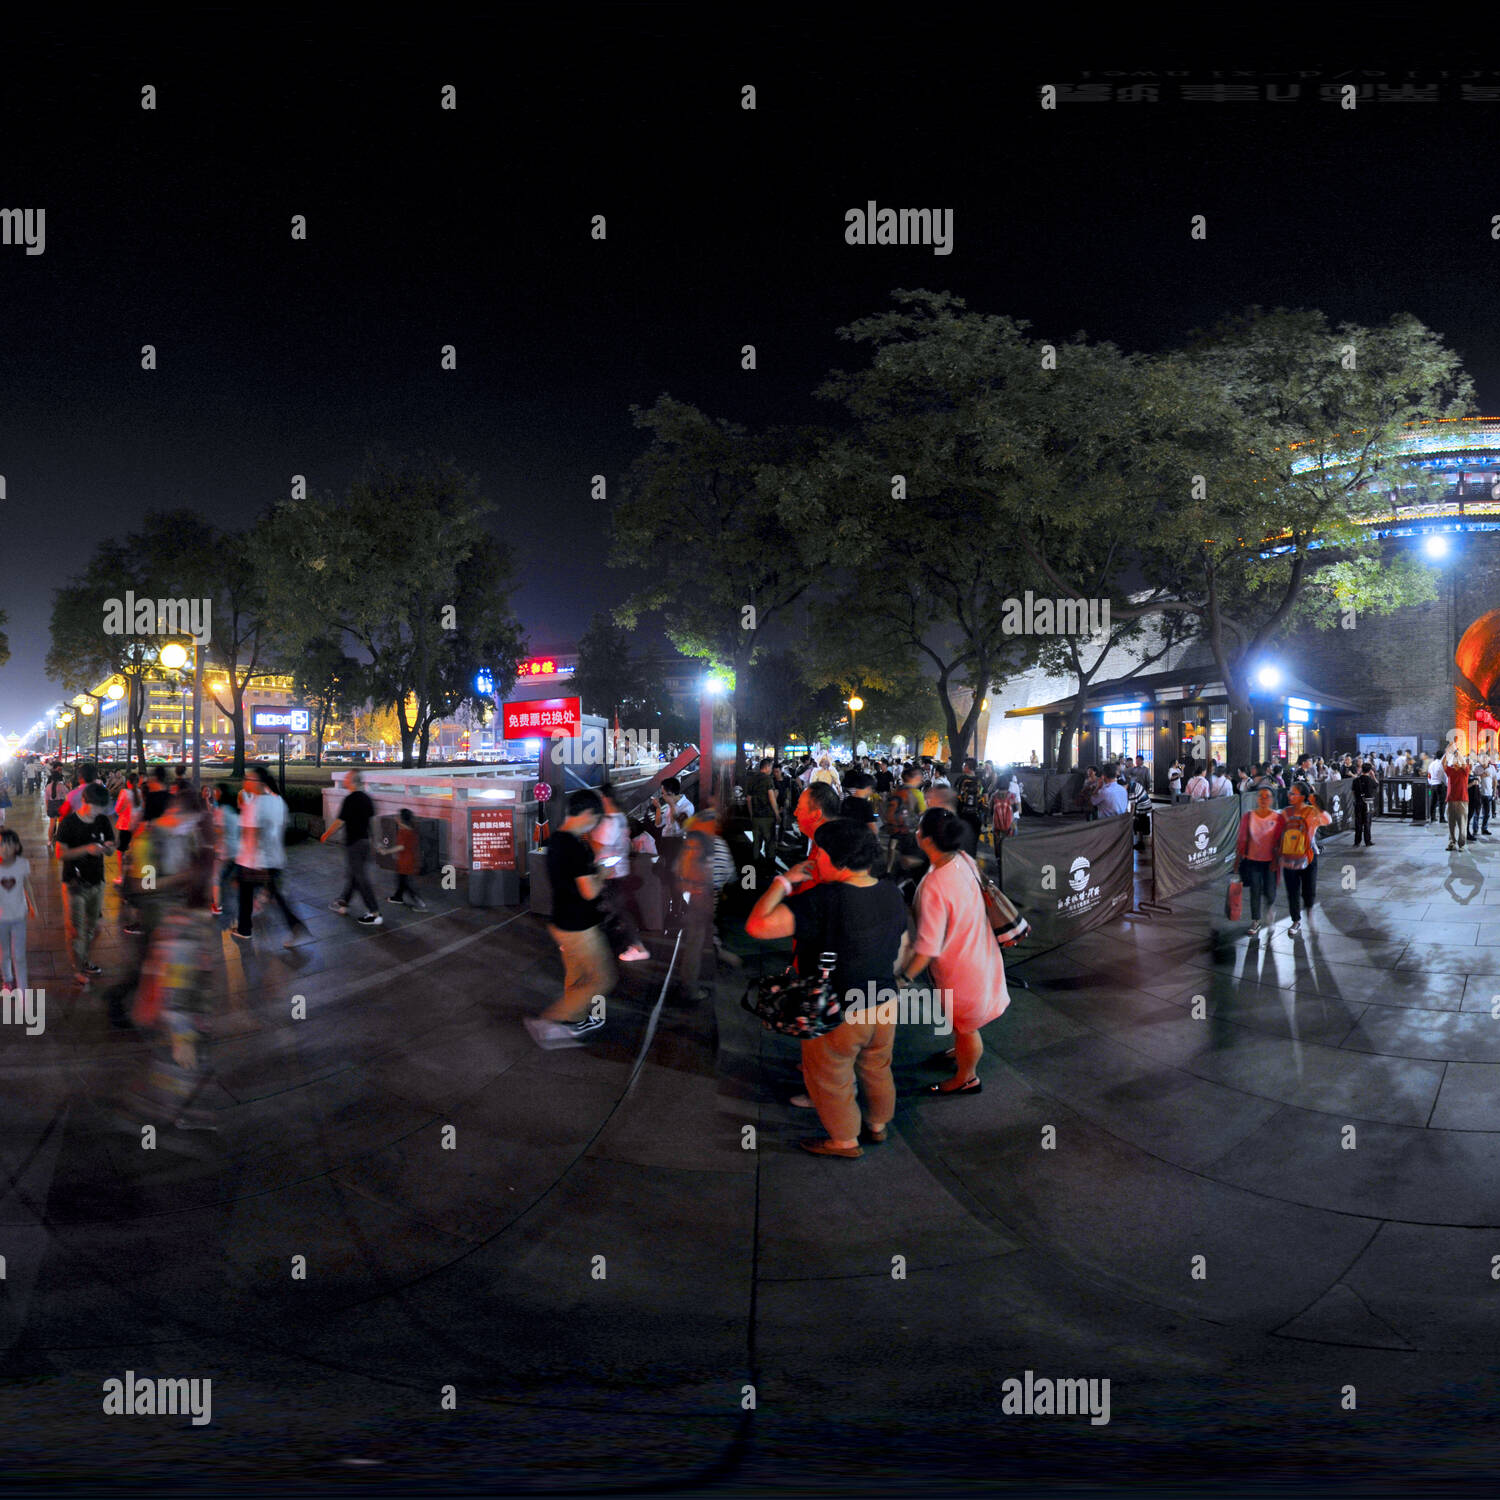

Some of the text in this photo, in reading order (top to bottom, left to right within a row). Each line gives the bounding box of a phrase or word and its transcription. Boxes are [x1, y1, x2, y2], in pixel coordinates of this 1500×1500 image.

[508, 709, 576, 728] 免费票兑换处
